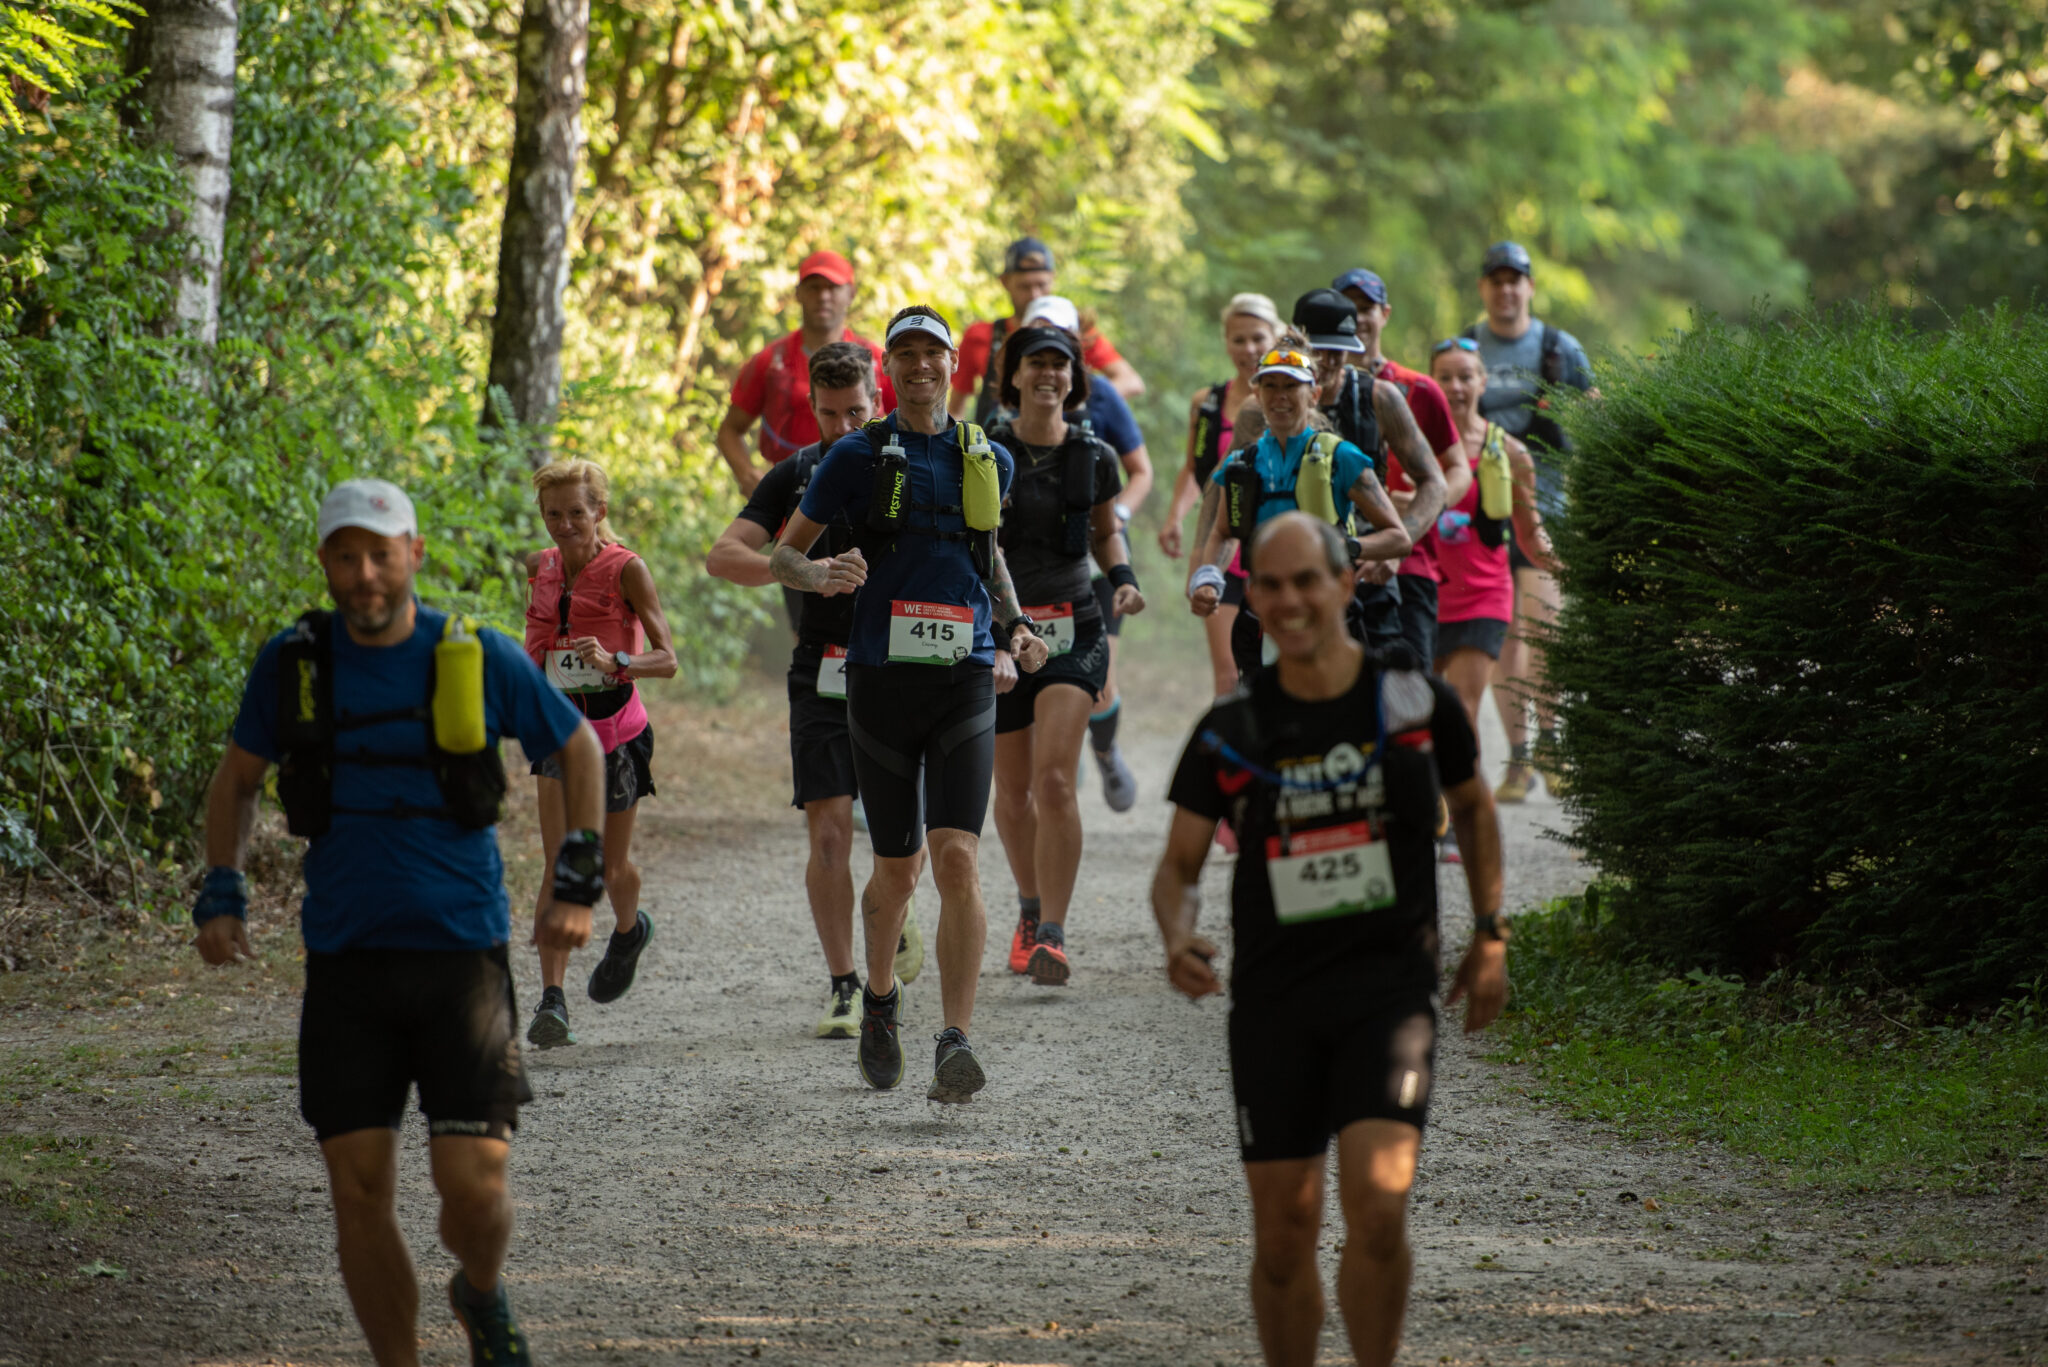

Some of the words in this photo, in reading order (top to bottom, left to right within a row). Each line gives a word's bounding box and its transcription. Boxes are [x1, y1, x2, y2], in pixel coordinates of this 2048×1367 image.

[904, 603, 922, 615] WE
[910, 621, 954, 641] 415
[1034, 622, 1056, 638] 24
[555, 637, 569, 648] WE
[560, 654, 597, 670] 41
[1299, 854, 1361, 882] 425
